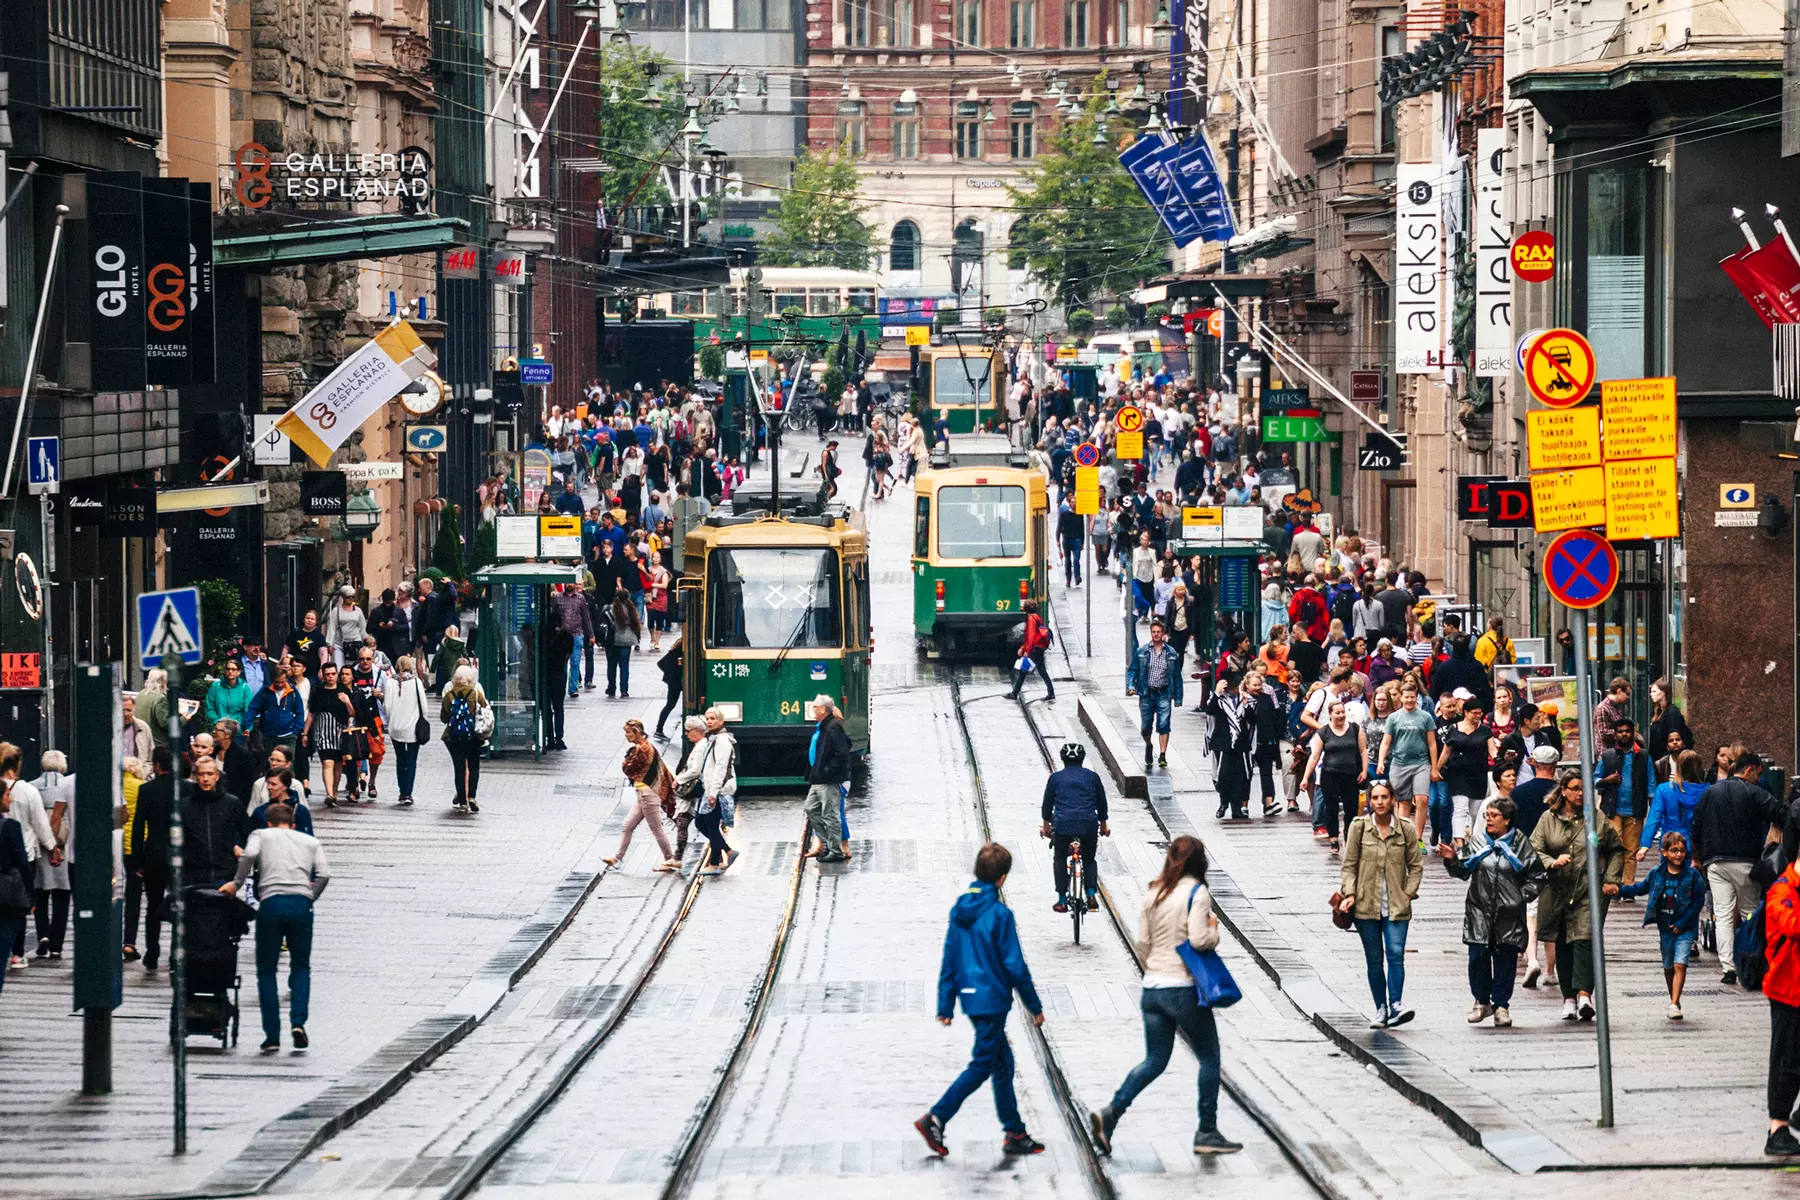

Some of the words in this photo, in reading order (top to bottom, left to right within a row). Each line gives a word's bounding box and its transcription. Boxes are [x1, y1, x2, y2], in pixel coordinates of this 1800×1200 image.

[286, 153, 427, 172] GALLERIA
[287, 178, 427, 197] ESPLANAD
[446, 251, 477, 271] H&M
[1515, 245, 1554, 261] RAX
[203, 260, 211, 292] HOTEL
[495, 258, 522, 277] H&M
[1399, 213, 1437, 333] aleksi
[95, 245, 127, 317] GLO
[131, 264, 139, 296] HOTEL
[328, 356, 380, 401] GALLERIA
[523, 366, 550, 375] Fenno
[333, 362, 386, 407] ESPLANAD
[340, 391, 364, 413] FASHION
[1361, 450, 1391, 467] Zio
[1644, 465, 1657, 475] att
[1611, 480, 1641, 490] stanna
[1644, 478, 1655, 488] på
[311, 497, 341, 506] BOSS
[1122, 496, 1132, 507] S
[1648, 500, 1663, 509] och
[996, 600, 1010, 611] 97
[780, 701, 800, 715] 84
